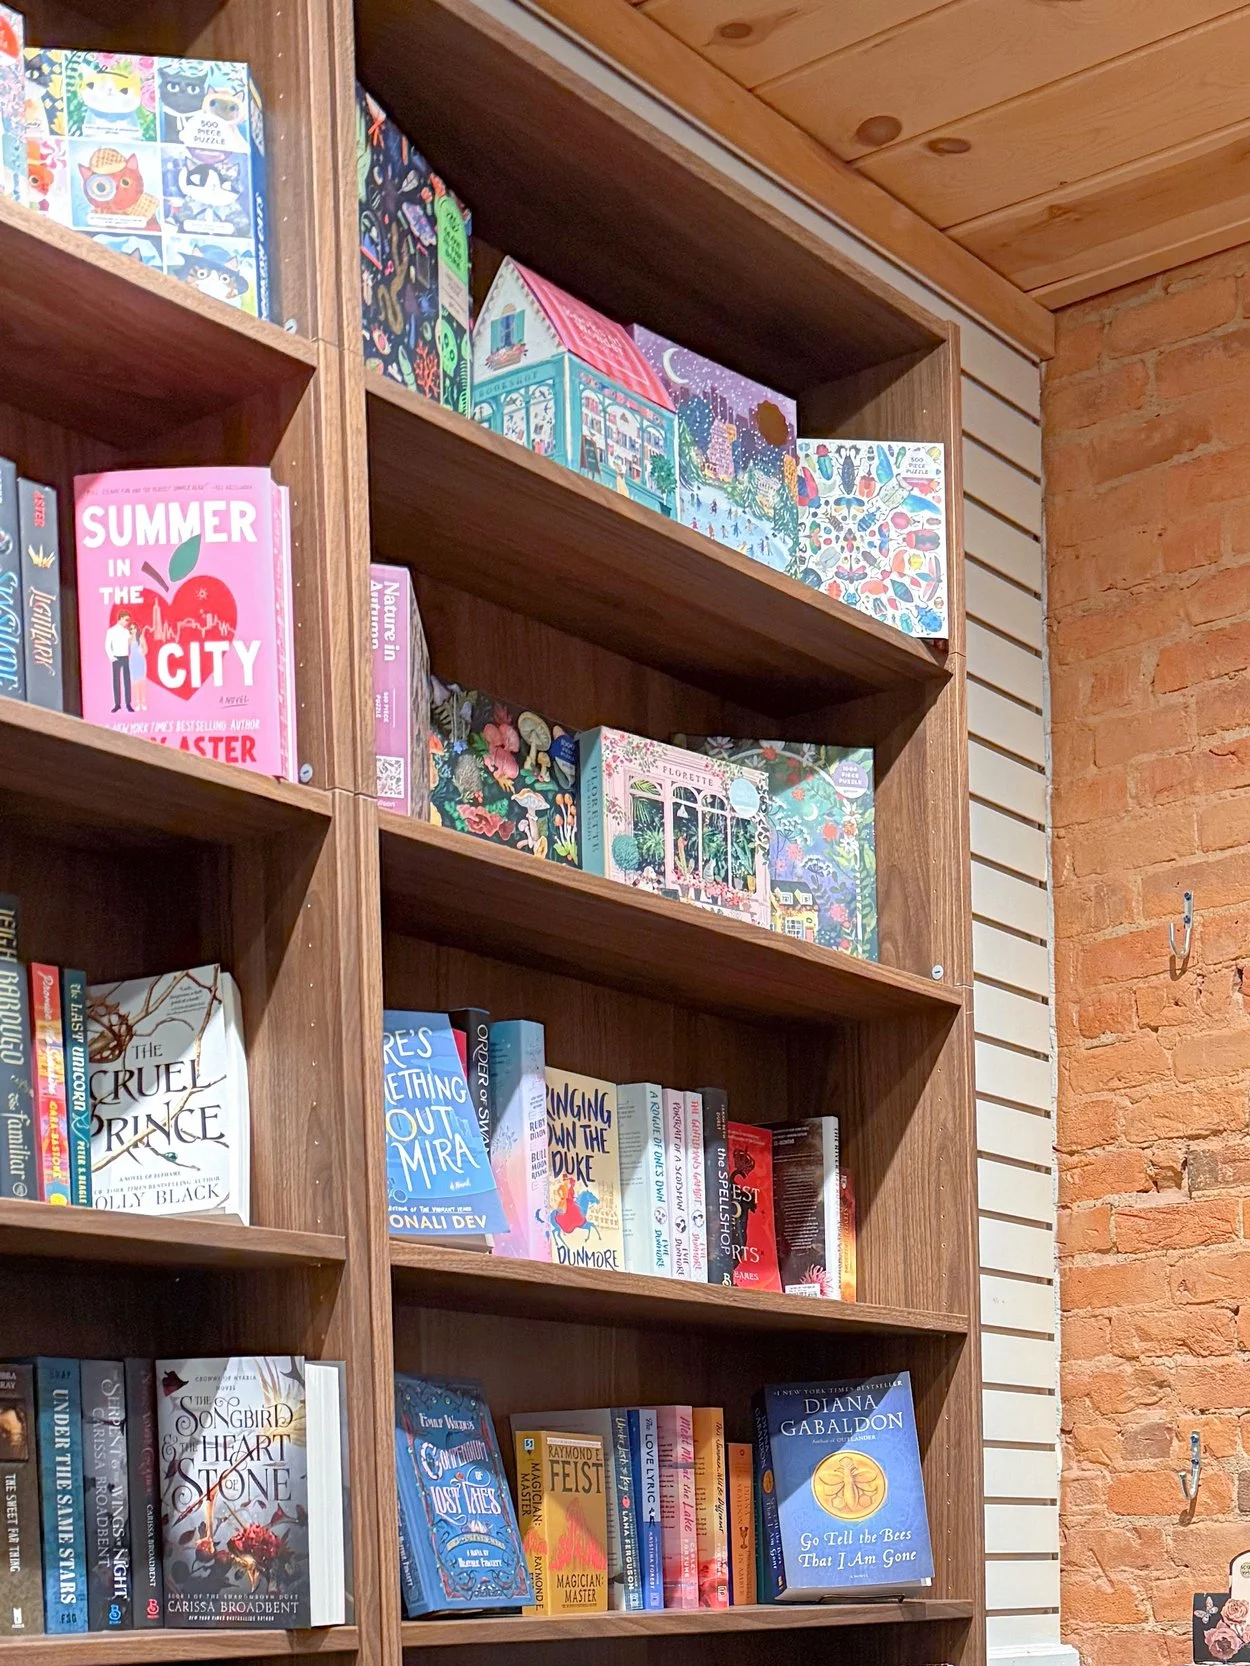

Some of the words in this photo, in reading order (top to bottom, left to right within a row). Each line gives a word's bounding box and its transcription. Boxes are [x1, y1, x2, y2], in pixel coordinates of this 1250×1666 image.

[194, 136, 226, 146] PUZZLE
[33, 491, 46, 528] ASTER
[82, 500, 257, 548] SUMMER
[108, 559, 130, 577] IN
[99, 586, 144, 605] THE
[384, 580, 400, 640] Nature
[157, 640, 262, 689] CITY
[384, 646, 400, 661] in
[151, 721, 173, 732] TIMES
[176, 720, 227, 732] BESTSELLING
[230, 719, 260, 731] AUTHOR
[1, 968, 24, 1065] BARDUGO
[70, 1003, 83, 1042] LAST
[131, 1043, 163, 1059] THE
[473, 1025, 489, 1087] ORDER
[71, 1046, 84, 1111] UNICORN
[89, 1058, 211, 1105] CRUEL
[650, 1100, 661, 1135] ROGUE
[672, 1102, 682, 1144] PORTRAIT
[8, 1111, 30, 1182] familiar
[77, 1141, 85, 1166] PETER
[531, 1150, 547, 1162] BULL
[580, 1125, 610, 1154] THE
[391, 1135, 480, 1191] MIRA
[552, 1150, 596, 1187] DUKE
[717, 1148, 726, 1168] the
[156, 1183, 221, 1204] BLACK
[655, 1182, 666, 1209] OWN
[452, 1214, 487, 1229] DEV
[718, 1170, 731, 1256] SPELLSHOP
[558, 1246, 619, 1268] DUNMORE
[195, 1396, 213, 1405] THE
[856, 1380, 903, 1391] BESTSELLER
[52, 1389, 69, 1449] UNDER
[101, 1379, 122, 1451] SERPENT
[175, 1395, 294, 1437] SONGBIRD
[804, 1394, 878, 1414] DIANA
[92, 1407, 106, 1471] CARISSA
[680, 1416, 693, 1443] Meet
[780, 1412, 904, 1437] GABALDON
[836, 1435, 876, 1443] OUTLANDER
[180, 1442, 198, 1452] THE
[202, 1434, 291, 1463] HEART
[420, 1441, 489, 1480] COMPENDIUM
[548, 1445, 593, 1459] RAYMOND
[645, 1433, 654, 1466] LOVE
[5, 1473, 17, 1491] THE
[55, 1453, 72, 1490] THE
[172, 1458, 292, 1512] STONE
[549, 1459, 604, 1495] FEIST
[646, 1468, 656, 1504] LYRIC
[6, 1493, 18, 1525] SWEET
[111, 1486, 125, 1537] WINGS
[520, 1473, 532, 1516] MASTER
[531, 1463, 543, 1526] MAGICIAN:
[56, 1496, 73, 1545] SAME
[683, 1502, 694, 1533] Lake
[800, 1532, 820, 1551] Go
[824, 1530, 854, 1545] Tell
[859, 1529, 877, 1544] the
[880, 1527, 912, 1542] Bees
[9, 1543, 21, 1572] THING
[112, 1547, 130, 1601] NIGHT
[625, 1538, 634, 1590] FERGUSON
[798, 1553, 833, 1568] That
[847, 1553, 876, 1566] Am
[882, 1549, 917, 1569] Gone
[58, 1547, 76, 1604] STARS
[533, 1555, 544, 1598] RAYMOND
[557, 1574, 604, 1588] MAGICIAN:
[168, 1601, 215, 1613] CARISSA
[220, 1601, 299, 1614] BROADBENT
[564, 1588, 597, 1603] MASTER
